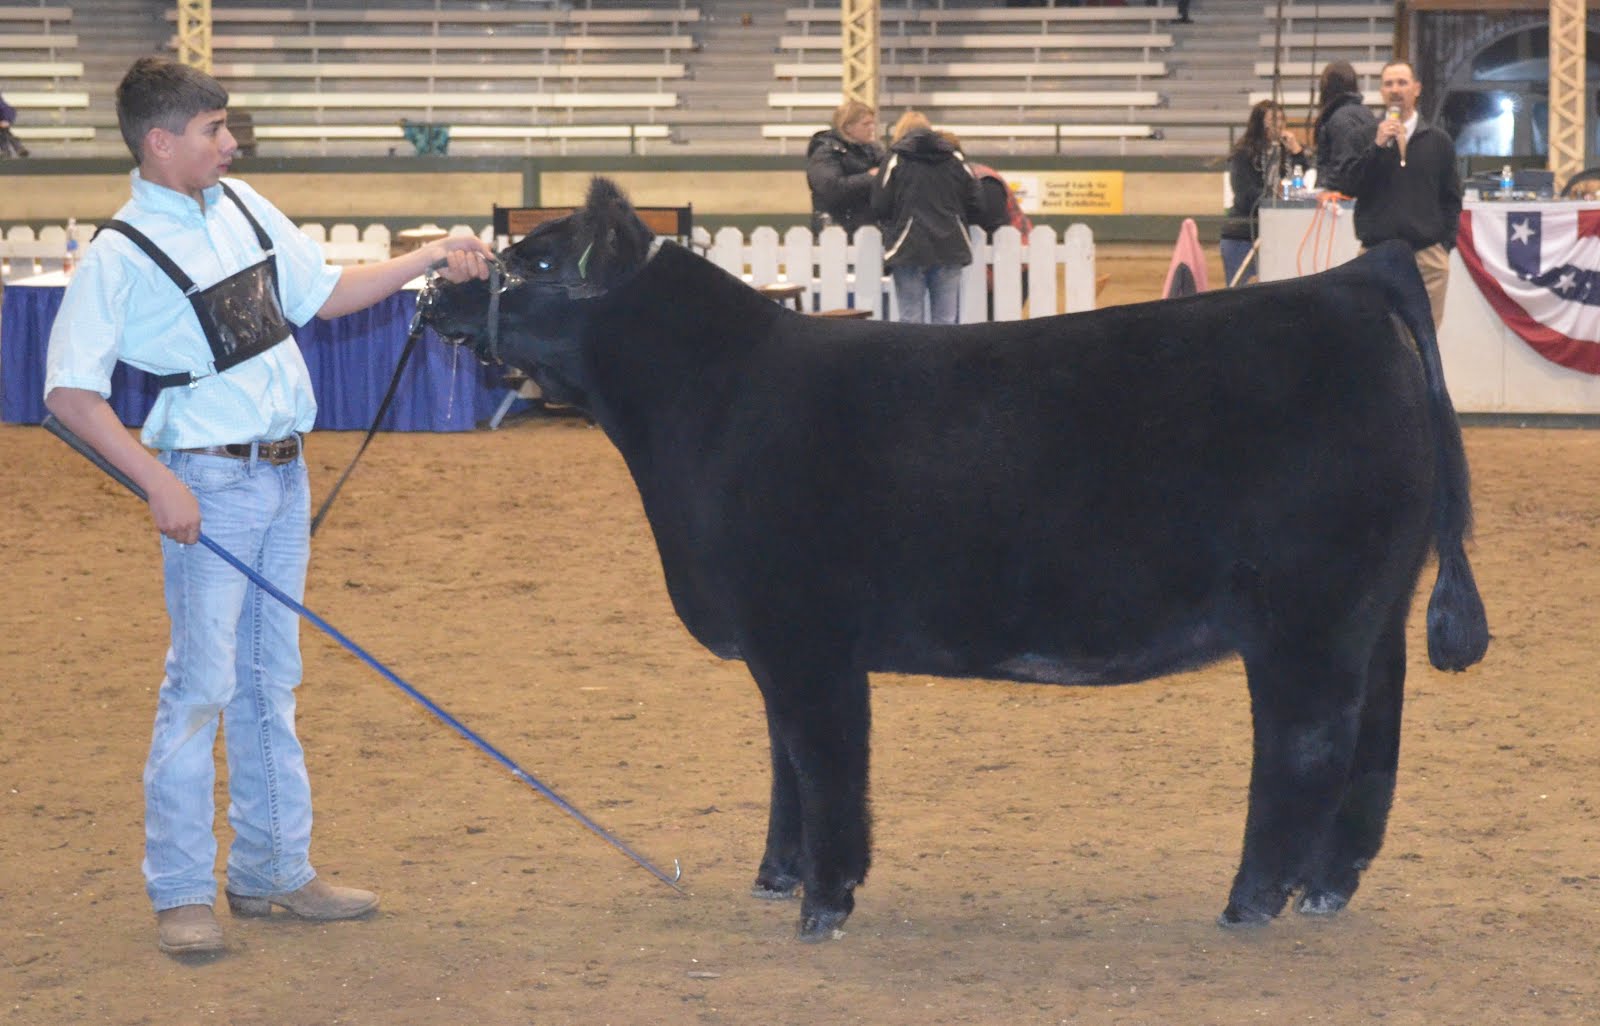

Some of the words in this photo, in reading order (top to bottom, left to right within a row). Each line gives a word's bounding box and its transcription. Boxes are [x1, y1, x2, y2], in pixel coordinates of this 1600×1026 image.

[1045, 181, 1069, 189] Good
[1072, 181, 1093, 189] Luck
[1065, 191, 1104, 199] Breeding
